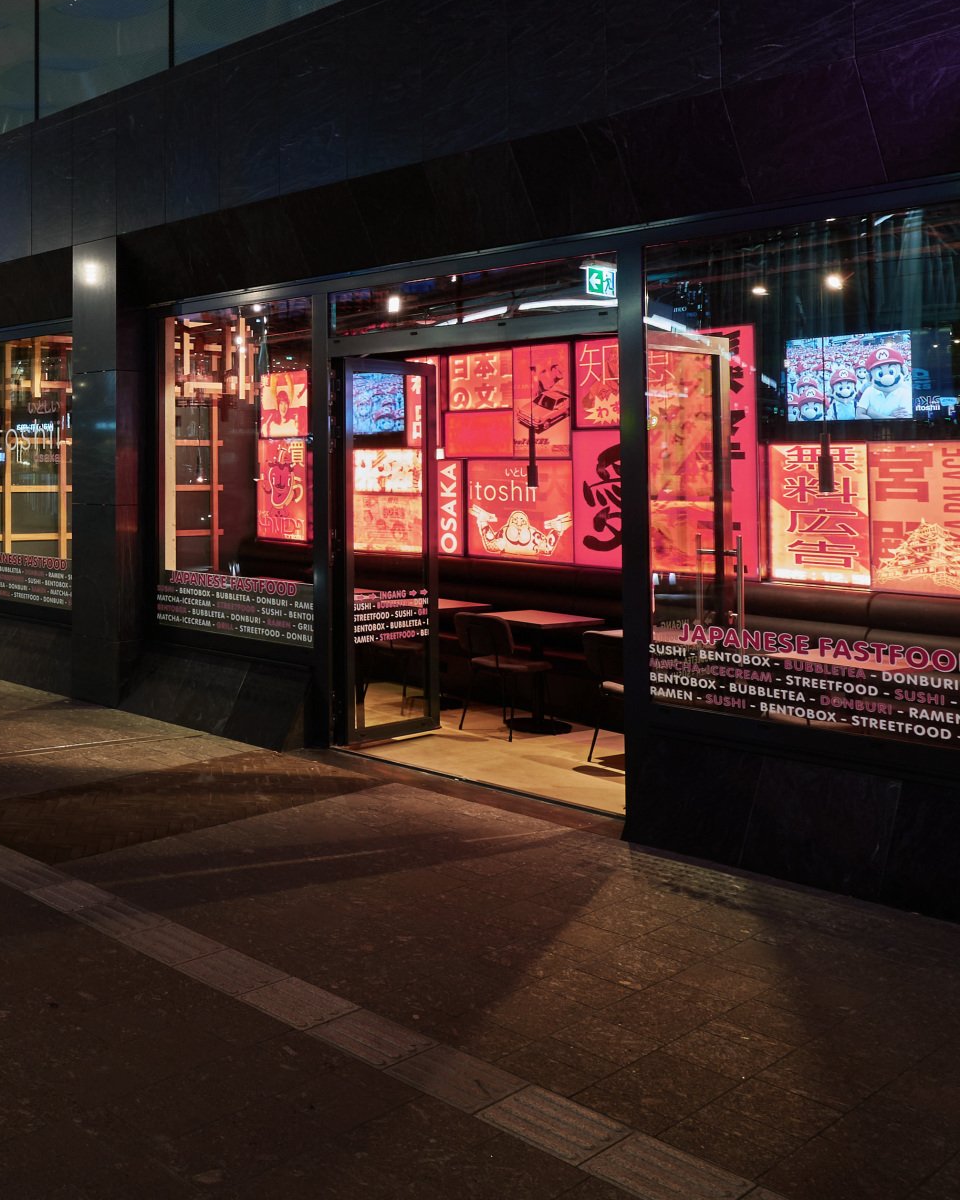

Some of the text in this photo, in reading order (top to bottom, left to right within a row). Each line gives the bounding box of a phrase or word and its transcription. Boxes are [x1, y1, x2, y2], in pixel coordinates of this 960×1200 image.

[505, 467, 530, 477] いとし
[440, 463, 458, 554] OSAKA
[783, 445, 859, 569] 無料広告
[23, 555, 68, 571] FASTFOOD
[170, 570, 297, 597] JAPANESE FASTFOOD
[380, 590, 407, 600] INGANG
[156, 594, 211, 607] MATCHA-ICECREAM
[261, 607, 282, 617] SUSHI
[179, 587, 211, 598] BENTOBOX
[215, 591, 251, 602] BUBBLETEA
[256, 596, 288, 607] DONBURI
[354, 603, 372, 611] SUSHI
[156, 613, 211, 627] MATCHA-ICECREAM
[239, 625, 280, 638] STREETFOOD
[191, 608, 226, 619] BUBBLETEA
[230, 614, 261, 624] DONBURI
[354, 611, 390, 622] STREETFOOD
[394, 609, 413, 618] SUSHI
[390, 619, 422, 629] BUBBLETEA
[380, 630, 416, 641] STREETFOOD
[679, 623, 960, 673] JAPANESE FASTFOO
[648, 644, 959, 691] SUSHI BENTOBOX BUBBLETEA DONBURI
[649, 672, 717, 690] BENTOBOX
[729, 683, 806, 703] BUBBLETEA
[819, 694, 893, 716] DONBURI
[785, 675, 879, 697] STREETFOOD
[894, 688, 946, 706] SUSHI
[649, 686, 952, 740] RAMEN SUSHI BENTOBOX STREETFOOD
